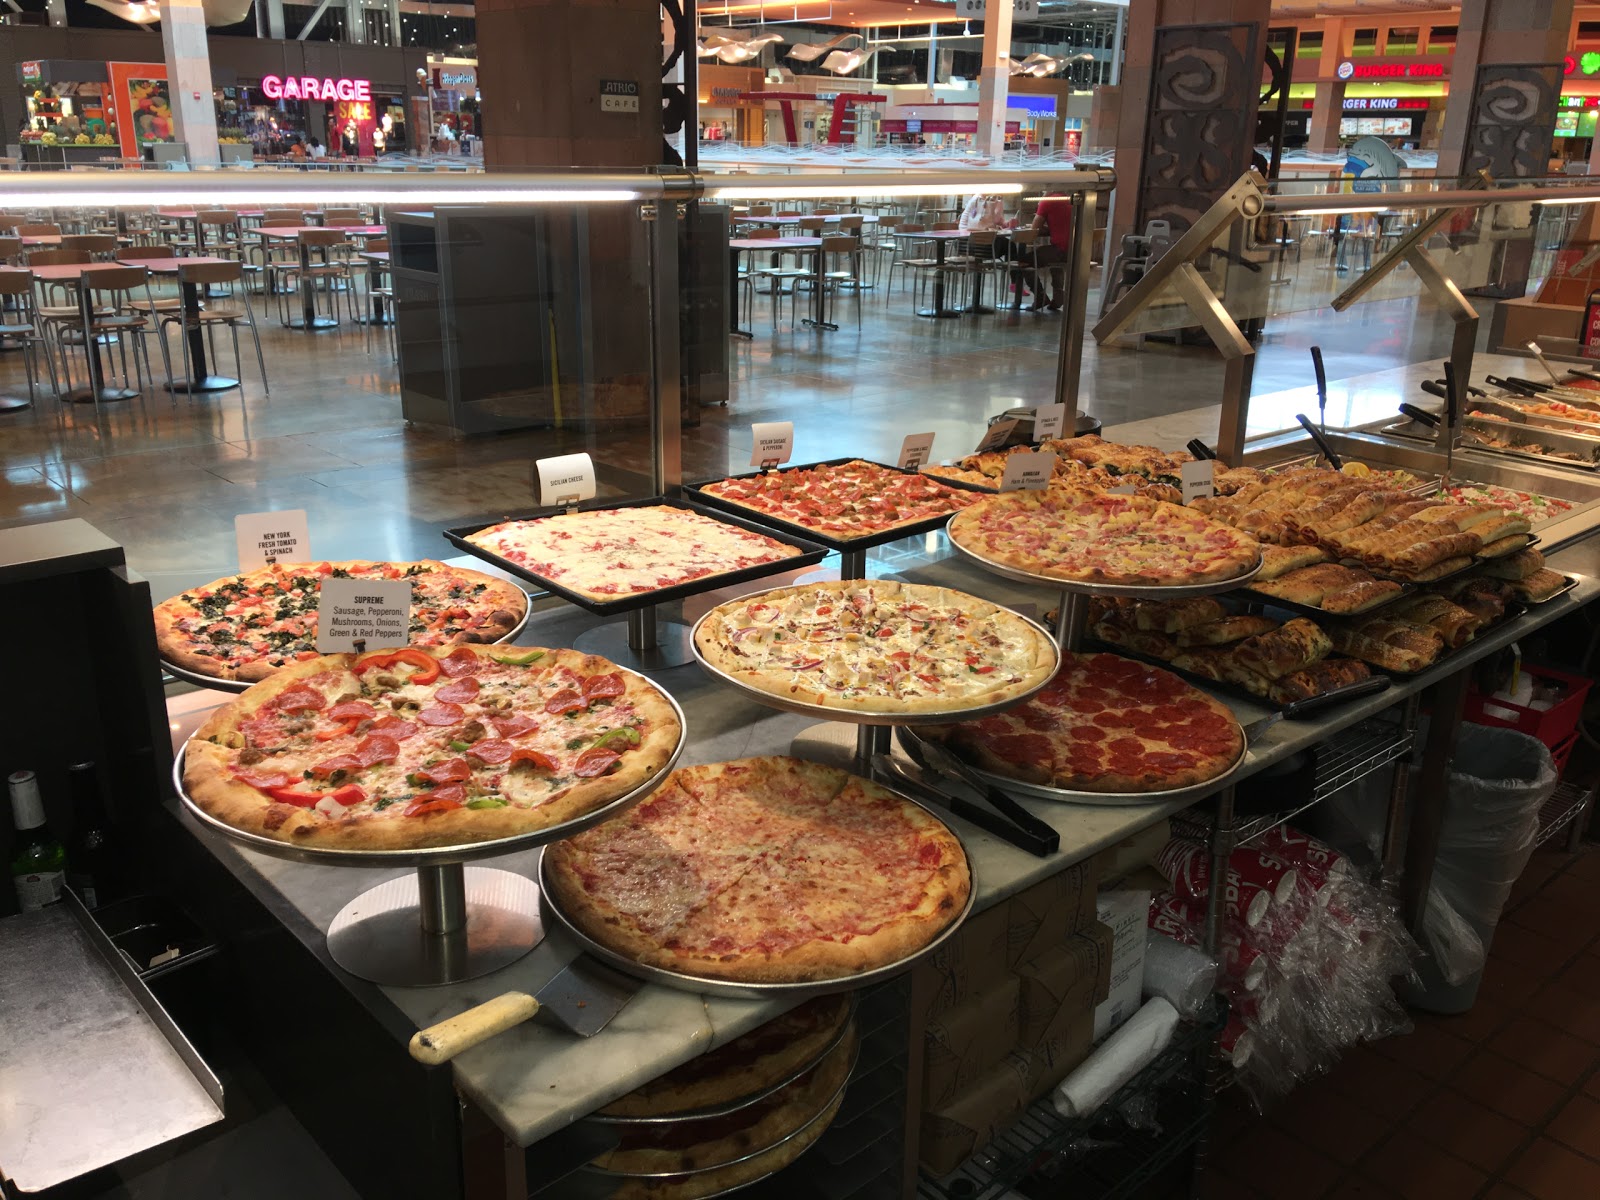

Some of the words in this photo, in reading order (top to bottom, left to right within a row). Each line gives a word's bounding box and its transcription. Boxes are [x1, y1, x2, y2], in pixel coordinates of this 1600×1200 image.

[1354, 64, 1406, 77] BURGER
[1409, 63, 1443, 76] KING
[262, 75, 371, 101] GARAGE
[605, 82, 636, 93] ATRIO
[605, 99, 637, 108] CAFE
[1370, 98, 1398, 109] KING
[338, 102, 372, 120] SALE
[550, 478, 568, 487] SICILIAN
[568, 475, 584, 483] CHEESE
[276, 531, 291, 539] YORK
[258, 541, 276, 549] FRESH
[276, 538, 297, 547] TOMATO
[269, 547, 293, 556] SPINACH
[354, 596, 384, 605] SUPREME
[333, 605, 366, 616] Sausage,
[367, 606, 404, 617] Pepperoni,
[331, 617, 374, 627] Mushrooms,
[376, 618, 402, 627] Onions,
[329, 628, 350, 637] Green
[351, 629, 357, 637] &
[359, 629, 373, 637] Red
[374, 629, 402, 639] Peppers
